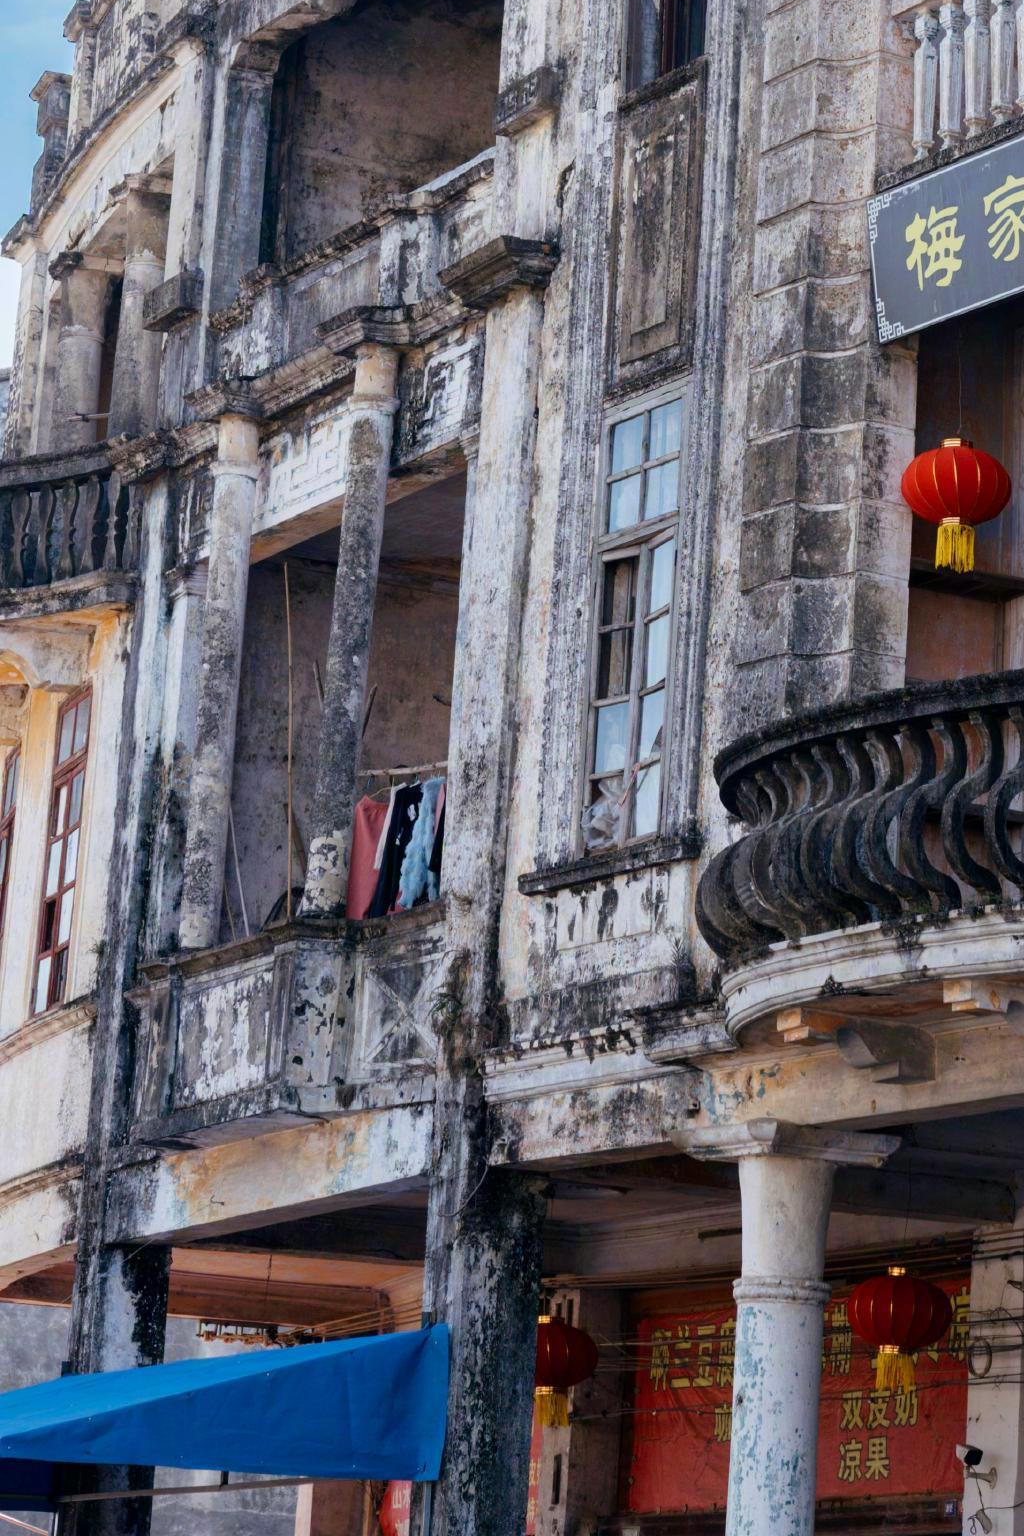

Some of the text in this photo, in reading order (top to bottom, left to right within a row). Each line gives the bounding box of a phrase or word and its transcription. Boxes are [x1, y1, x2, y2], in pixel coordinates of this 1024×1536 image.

[840, 1386, 919, 1430] 双皮奶
[838, 1437, 890, 1483] 凉果
